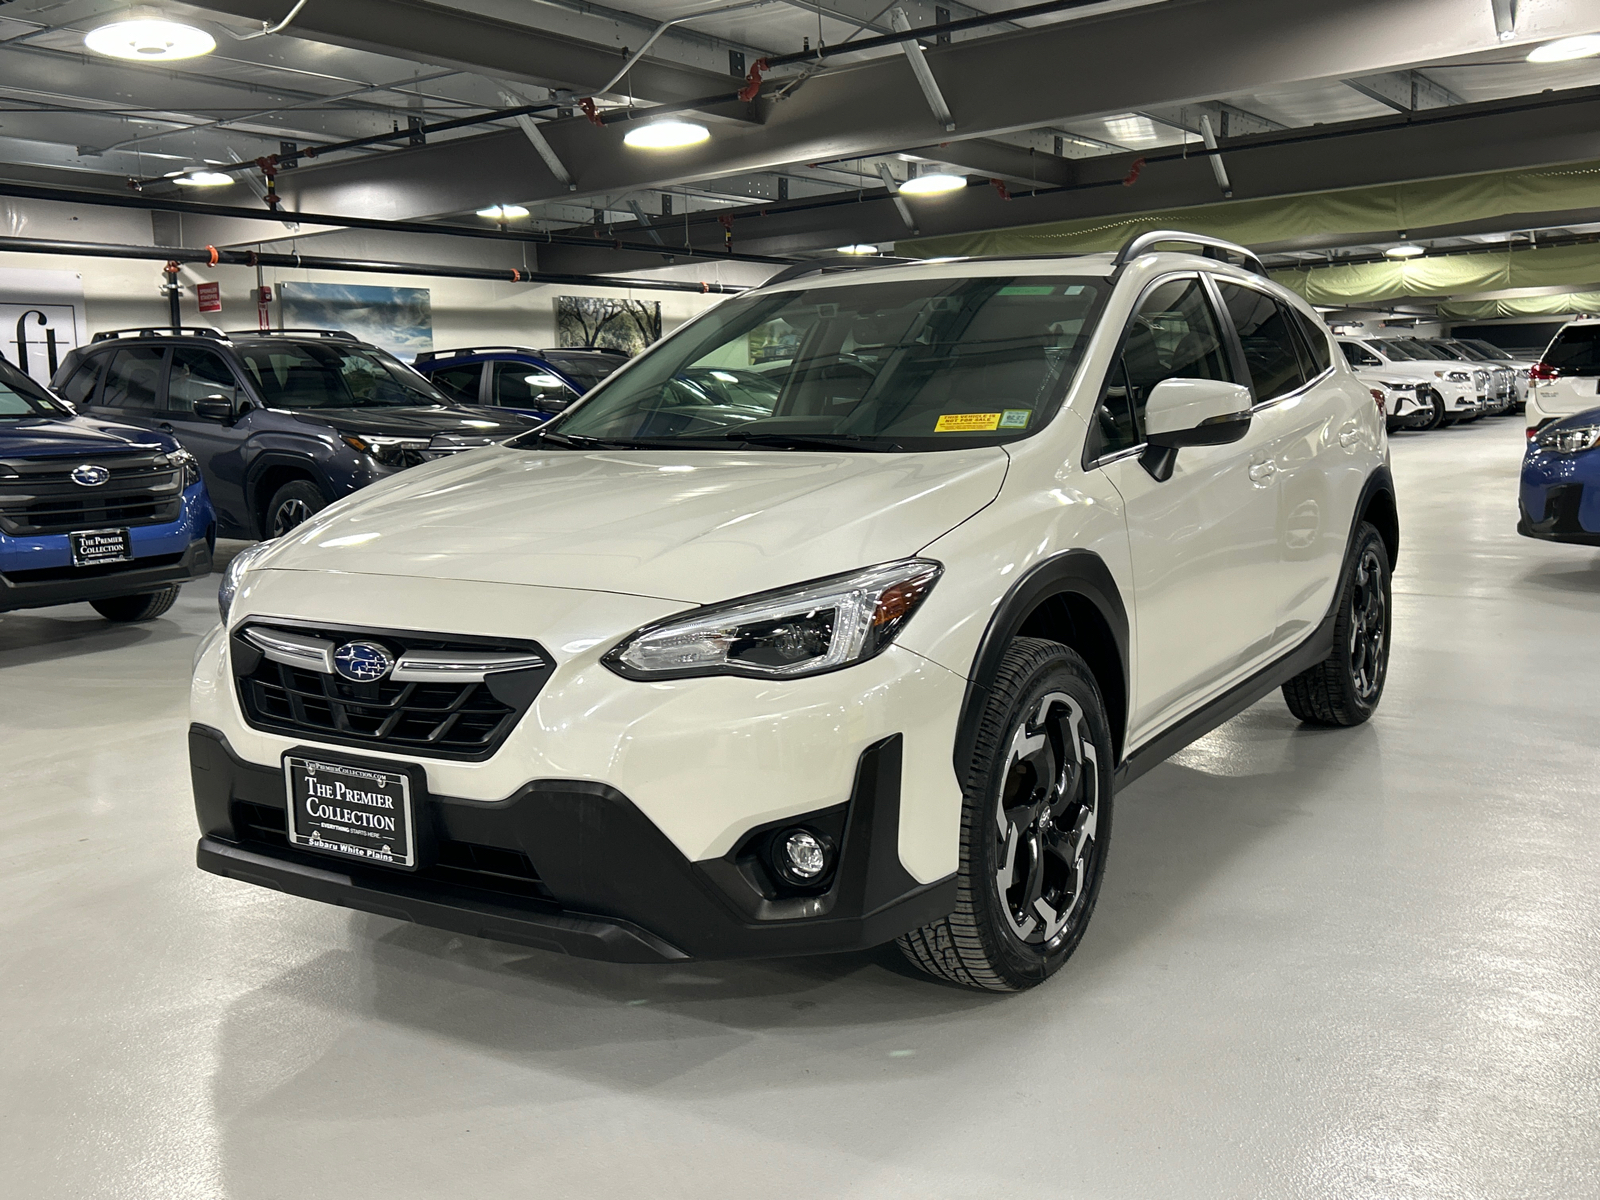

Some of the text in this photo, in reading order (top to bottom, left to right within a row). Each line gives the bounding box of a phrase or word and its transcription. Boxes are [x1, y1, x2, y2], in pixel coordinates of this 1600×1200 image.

[79, 536, 124, 547] THE PREMIER
[80, 544, 124, 555] COLLECTION
[304, 776, 395, 809] THE PREMIER
[305, 797, 395, 831] COLLECTION
[308, 837, 394, 862] Subaru White Plains
